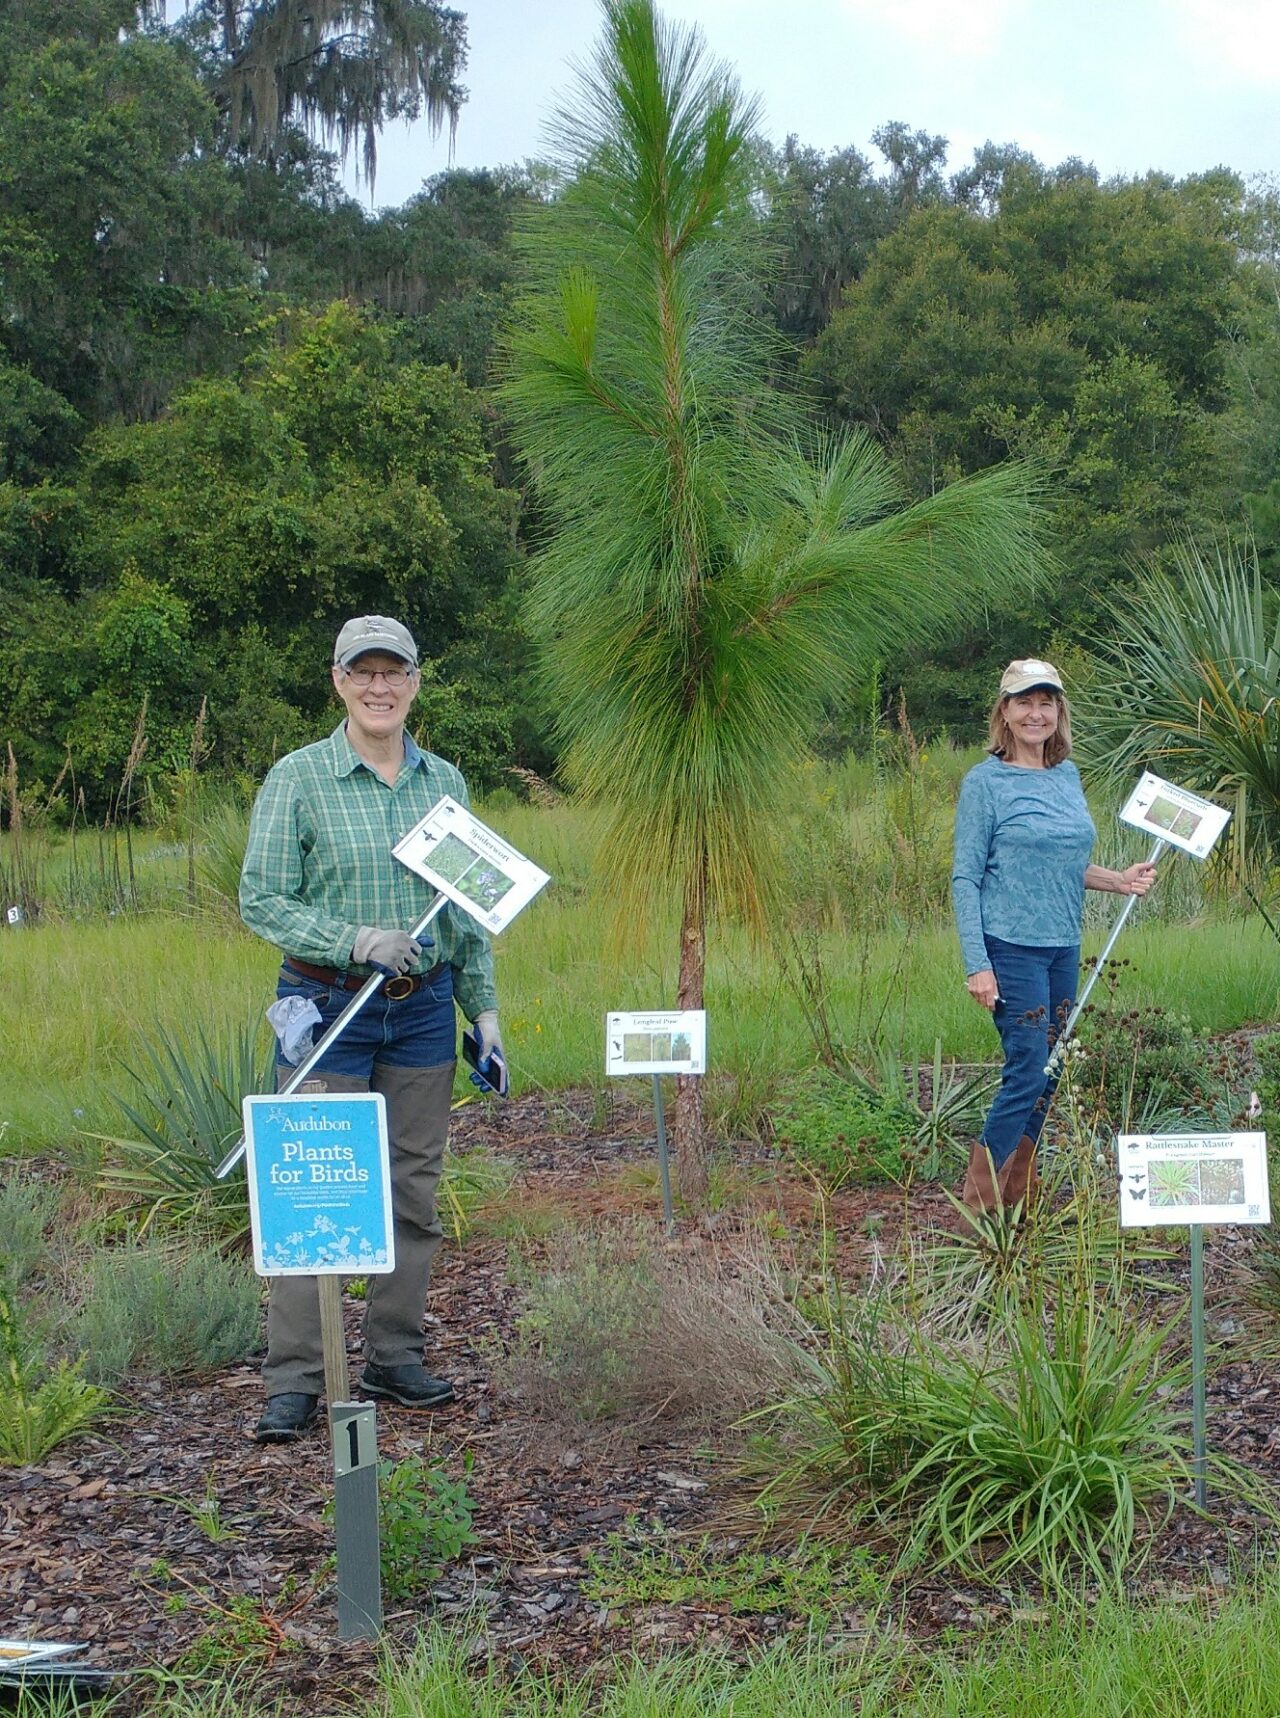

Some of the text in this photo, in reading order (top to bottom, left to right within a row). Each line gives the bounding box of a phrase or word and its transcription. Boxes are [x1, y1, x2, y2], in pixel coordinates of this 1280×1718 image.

[469, 828, 510, 863] Spiderwort
[633, 1018, 661, 1026] Longleaf
[281, 1116, 351, 1132] Audubon
[282, 1141, 354, 1161] Plants
[1145, 1140, 1235, 1150] Rattlesnake Master
[270, 1161, 369, 1184] for Birds
[346, 1419, 359, 1468] 1
